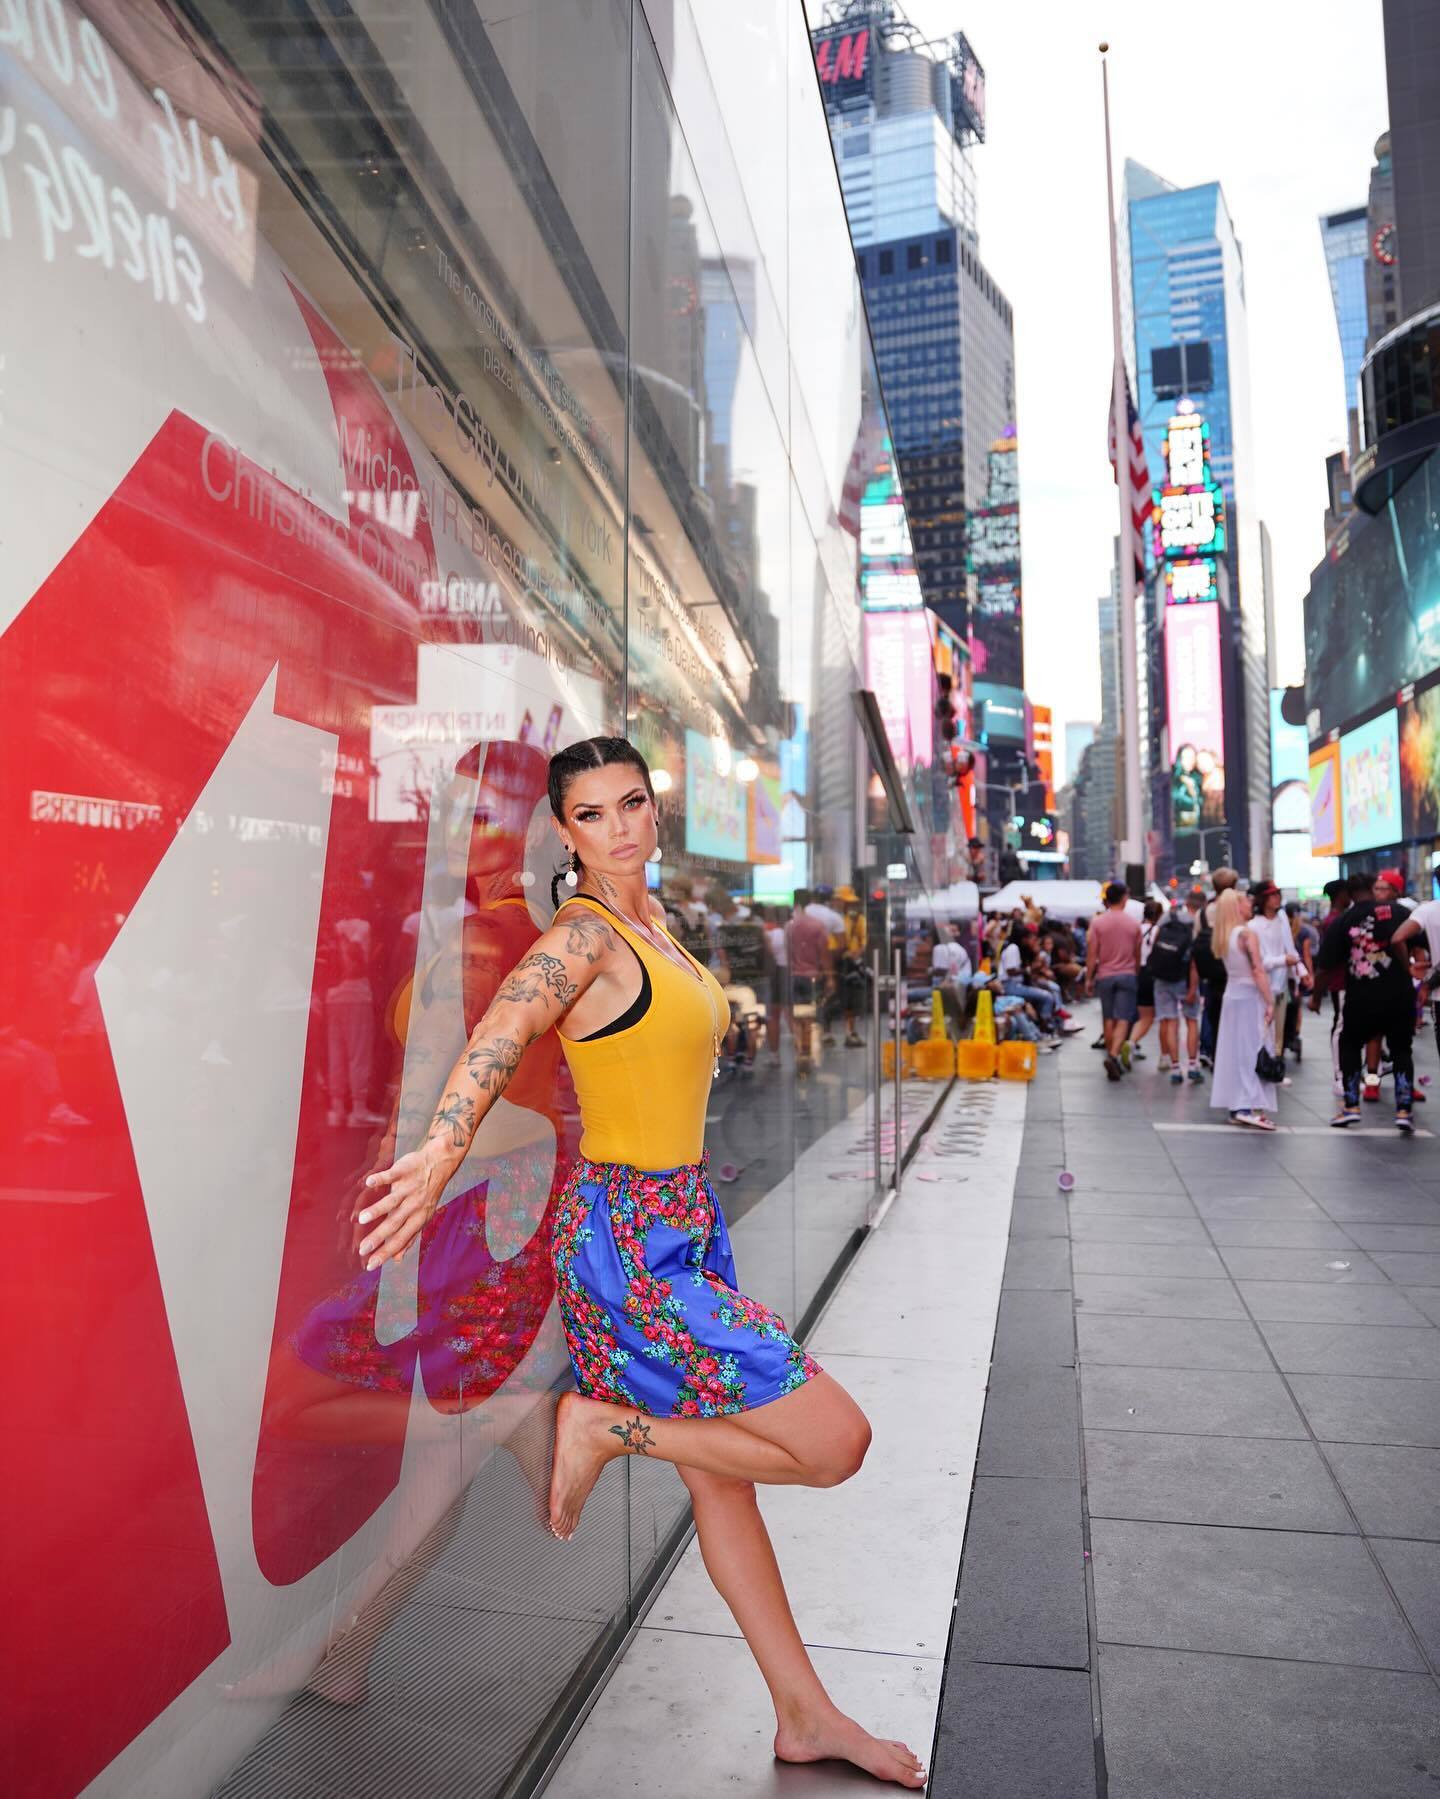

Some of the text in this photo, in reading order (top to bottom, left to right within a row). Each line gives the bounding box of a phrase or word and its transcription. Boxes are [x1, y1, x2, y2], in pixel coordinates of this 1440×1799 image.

[435, 245, 461, 295] The
[482, 347, 514, 393] plaza
[338, 415, 435, 527] Michael
[453, 392, 500, 488] City
[201, 432, 350, 555] Christine
